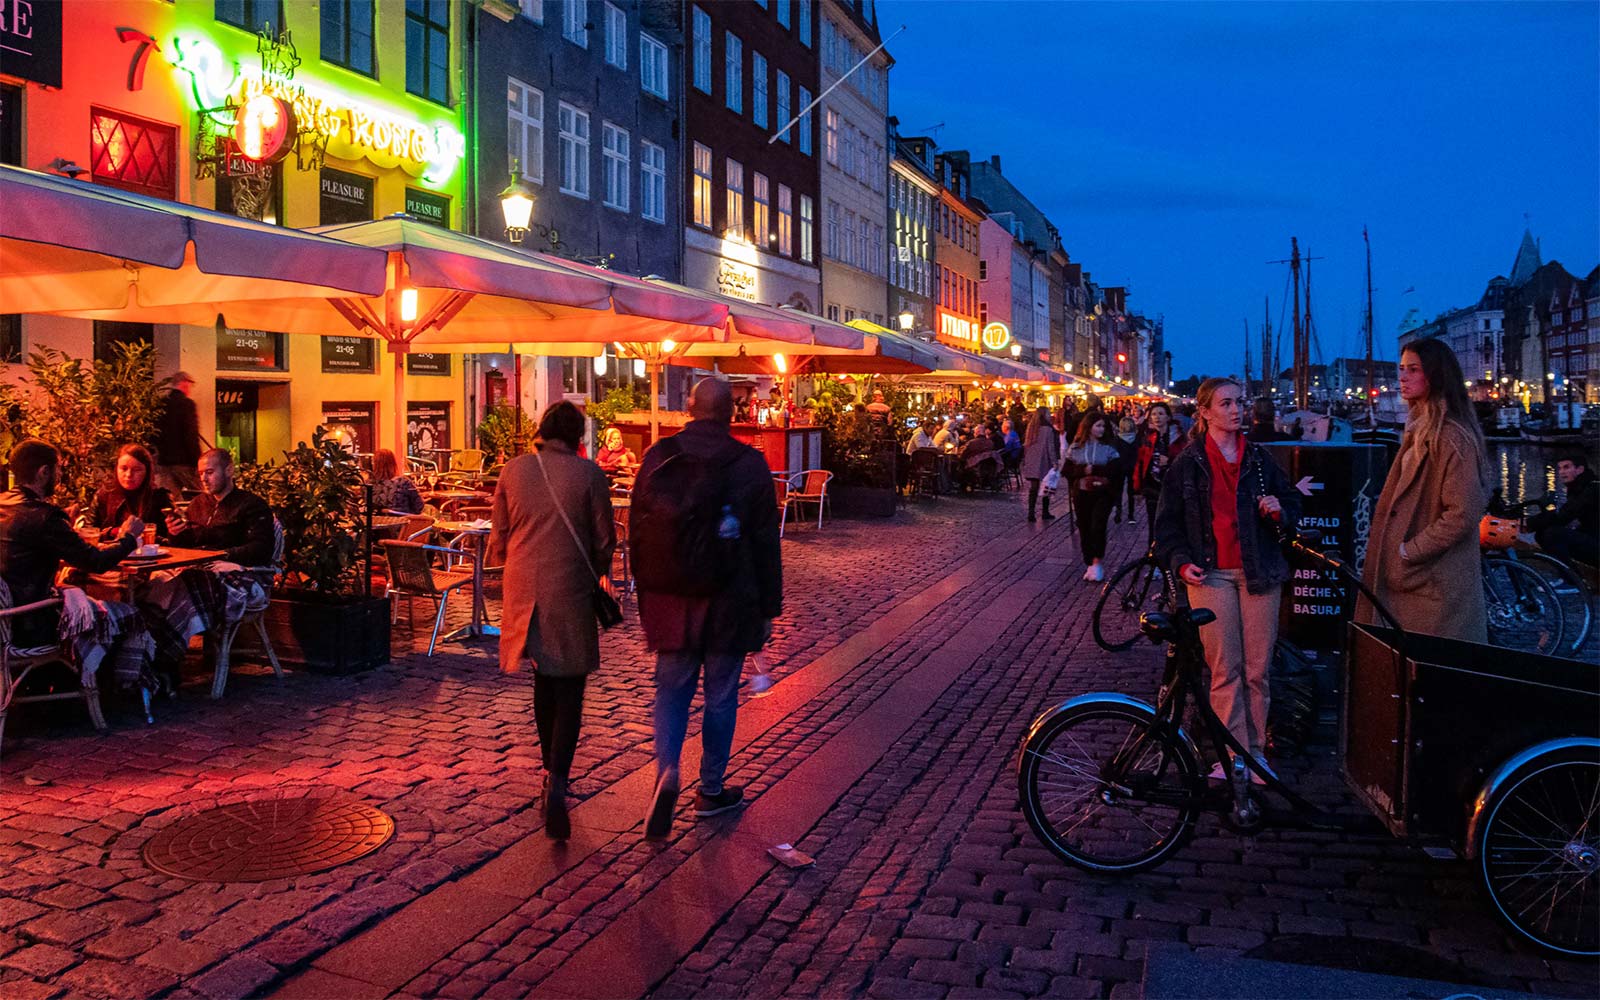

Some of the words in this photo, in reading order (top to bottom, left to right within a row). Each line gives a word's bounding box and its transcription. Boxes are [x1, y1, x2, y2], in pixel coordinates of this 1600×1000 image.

[115, 26, 161, 91] 7
[350, 108, 427, 163] KONG
[321, 178, 365, 200] PLEASURE
[407, 199, 442, 218] PLEASURE
[235, 338, 259, 350] 21-05
[986, 328, 1003, 346] 17
[335, 344, 354, 355] 21-05
[1293, 584, 1346, 598] DÉCHES
[1293, 603, 1341, 616] BASURA
